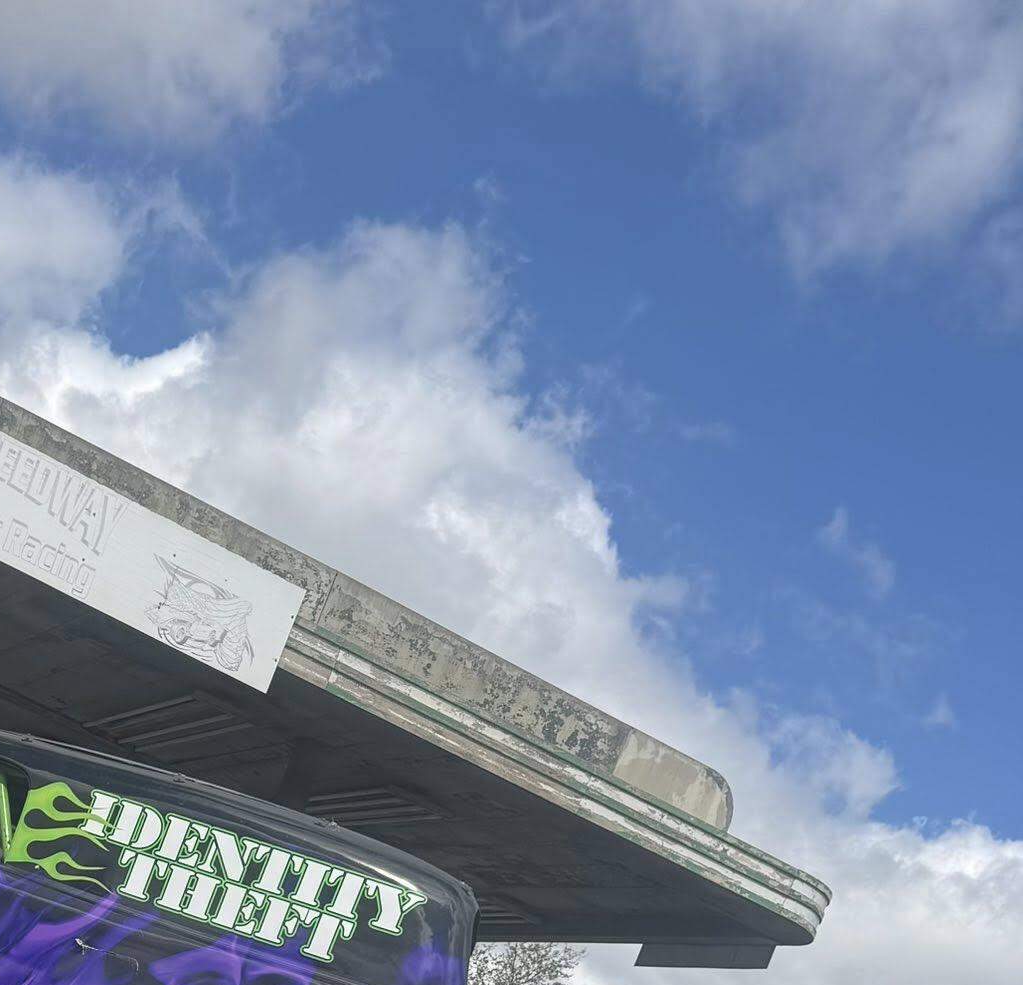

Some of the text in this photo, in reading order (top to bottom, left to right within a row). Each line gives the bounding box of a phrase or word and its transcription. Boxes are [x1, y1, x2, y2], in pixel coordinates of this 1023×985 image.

[2, 518, 97, 599] Racing
[80, 790, 427, 935] IDENTITY
[118, 844, 357, 962] THEFT
